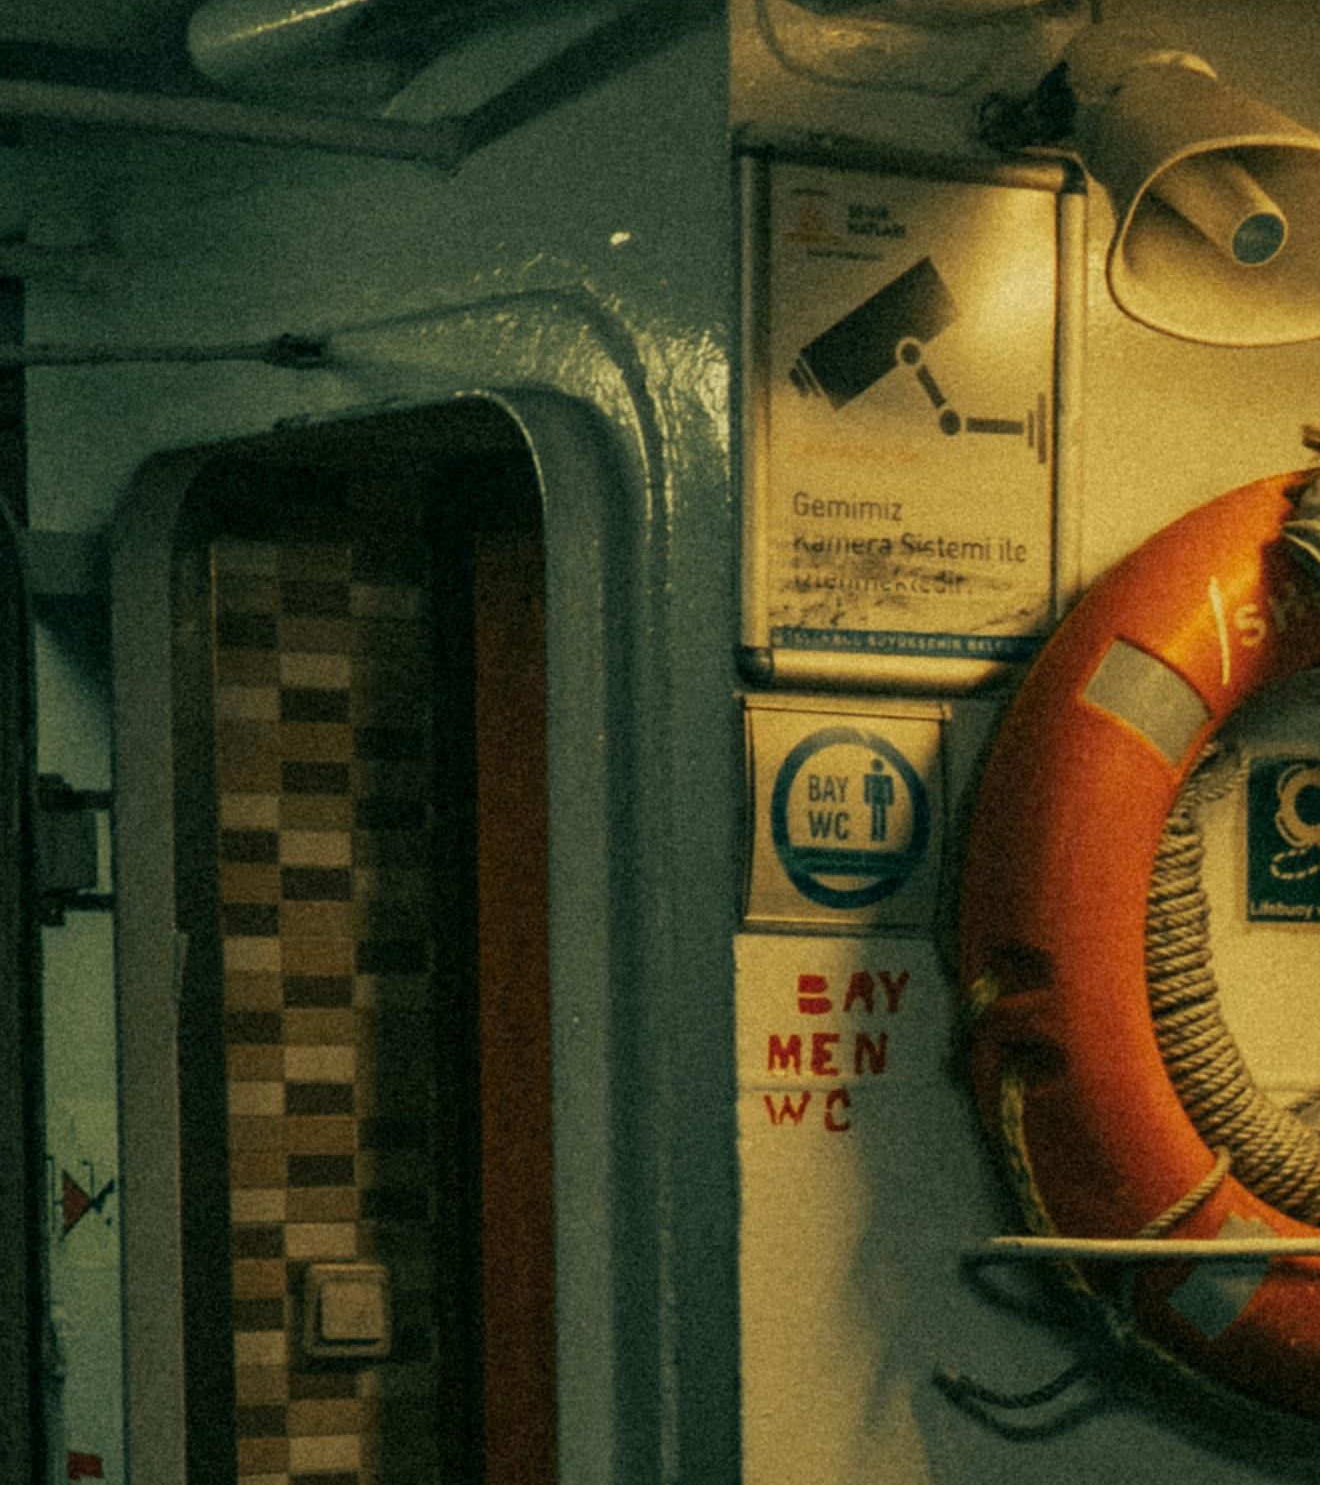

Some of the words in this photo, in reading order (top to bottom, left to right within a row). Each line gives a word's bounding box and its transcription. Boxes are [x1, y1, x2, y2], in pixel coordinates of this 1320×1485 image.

[793, 492, 902, 522] Gemimiz
[794, 533, 893, 557] Kamera
[900, 532, 992, 561] Sistemi
[997, 538, 1027, 564] ile
[808, 774, 849, 804] BAY
[808, 810, 850, 841] WC
[798, 970, 910, 1014] BAY
[767, 1032, 888, 1076] MEN
[763, 1088, 851, 1132] WC
